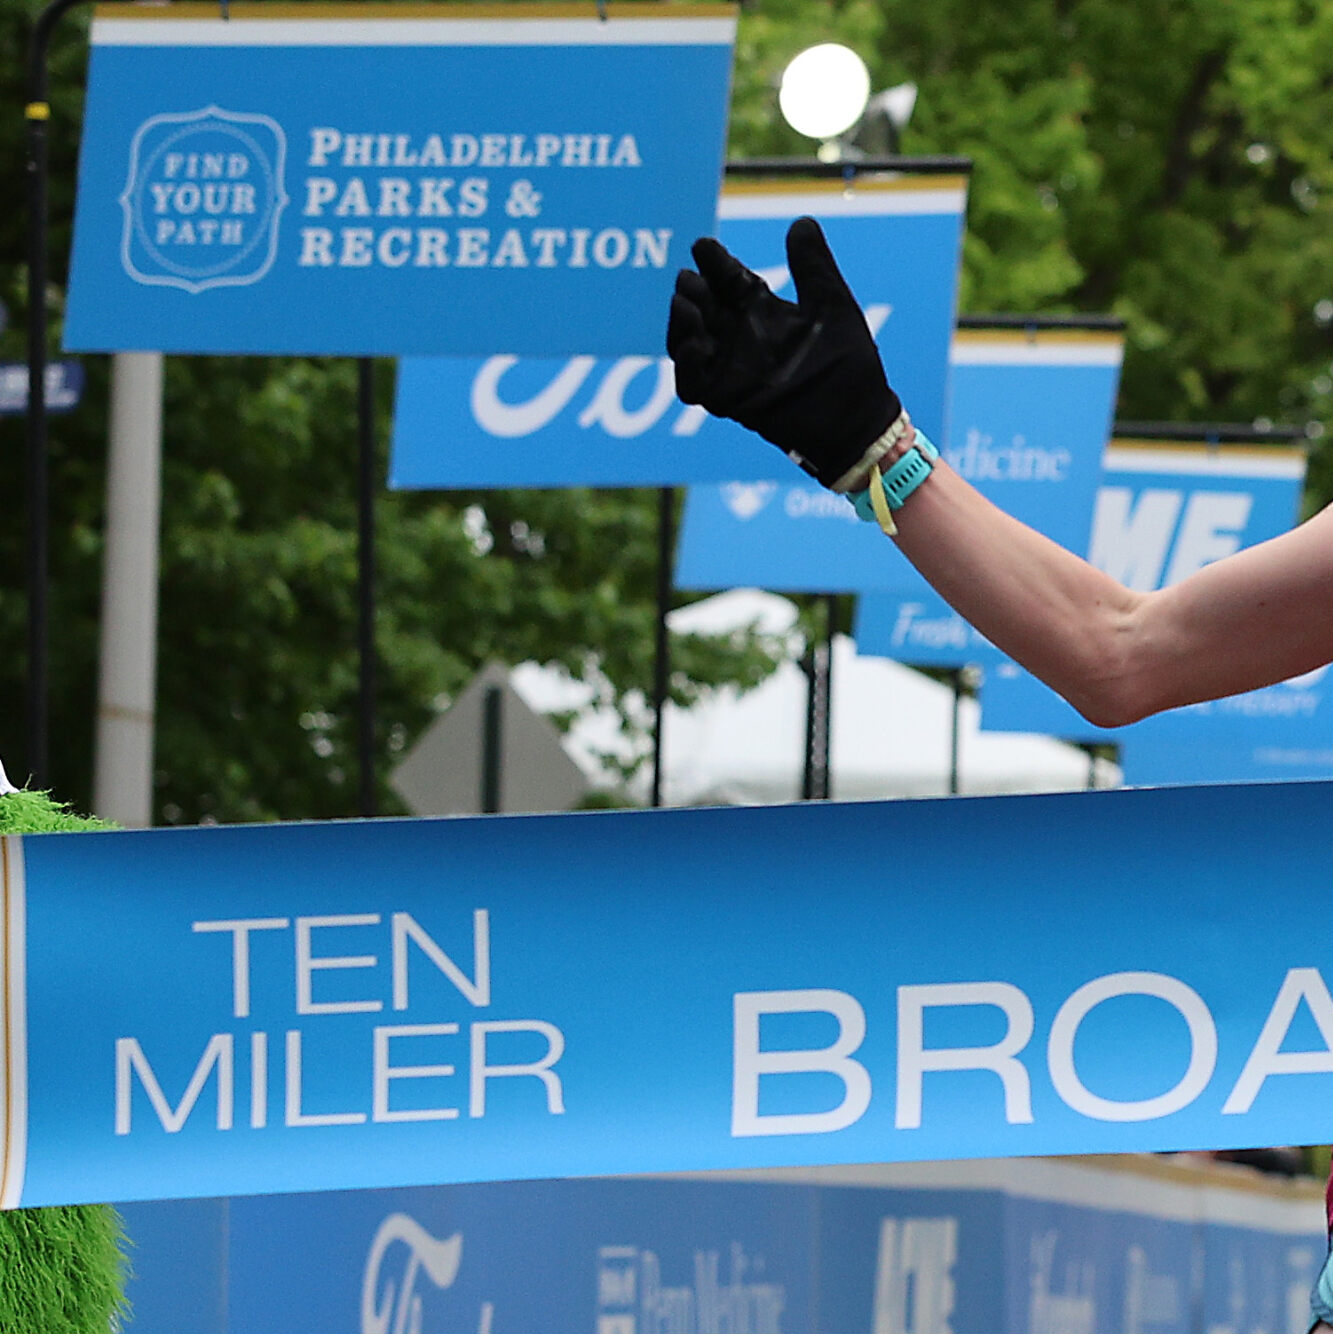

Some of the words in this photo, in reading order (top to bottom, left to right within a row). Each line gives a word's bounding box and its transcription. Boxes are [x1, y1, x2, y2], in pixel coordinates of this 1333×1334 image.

[164, 153, 249, 178] FIND
[309, 128, 642, 167] PHILADELPHIA
[151, 183, 256, 214] YOUR
[304, 178, 489, 217] PARKS
[505, 180, 542, 218] &
[156, 219, 243, 245] PATH
[299, 228, 673, 268] RECREATION
[192, 908, 491, 1018] TEN
[114, 1019, 566, 1136] MILER
